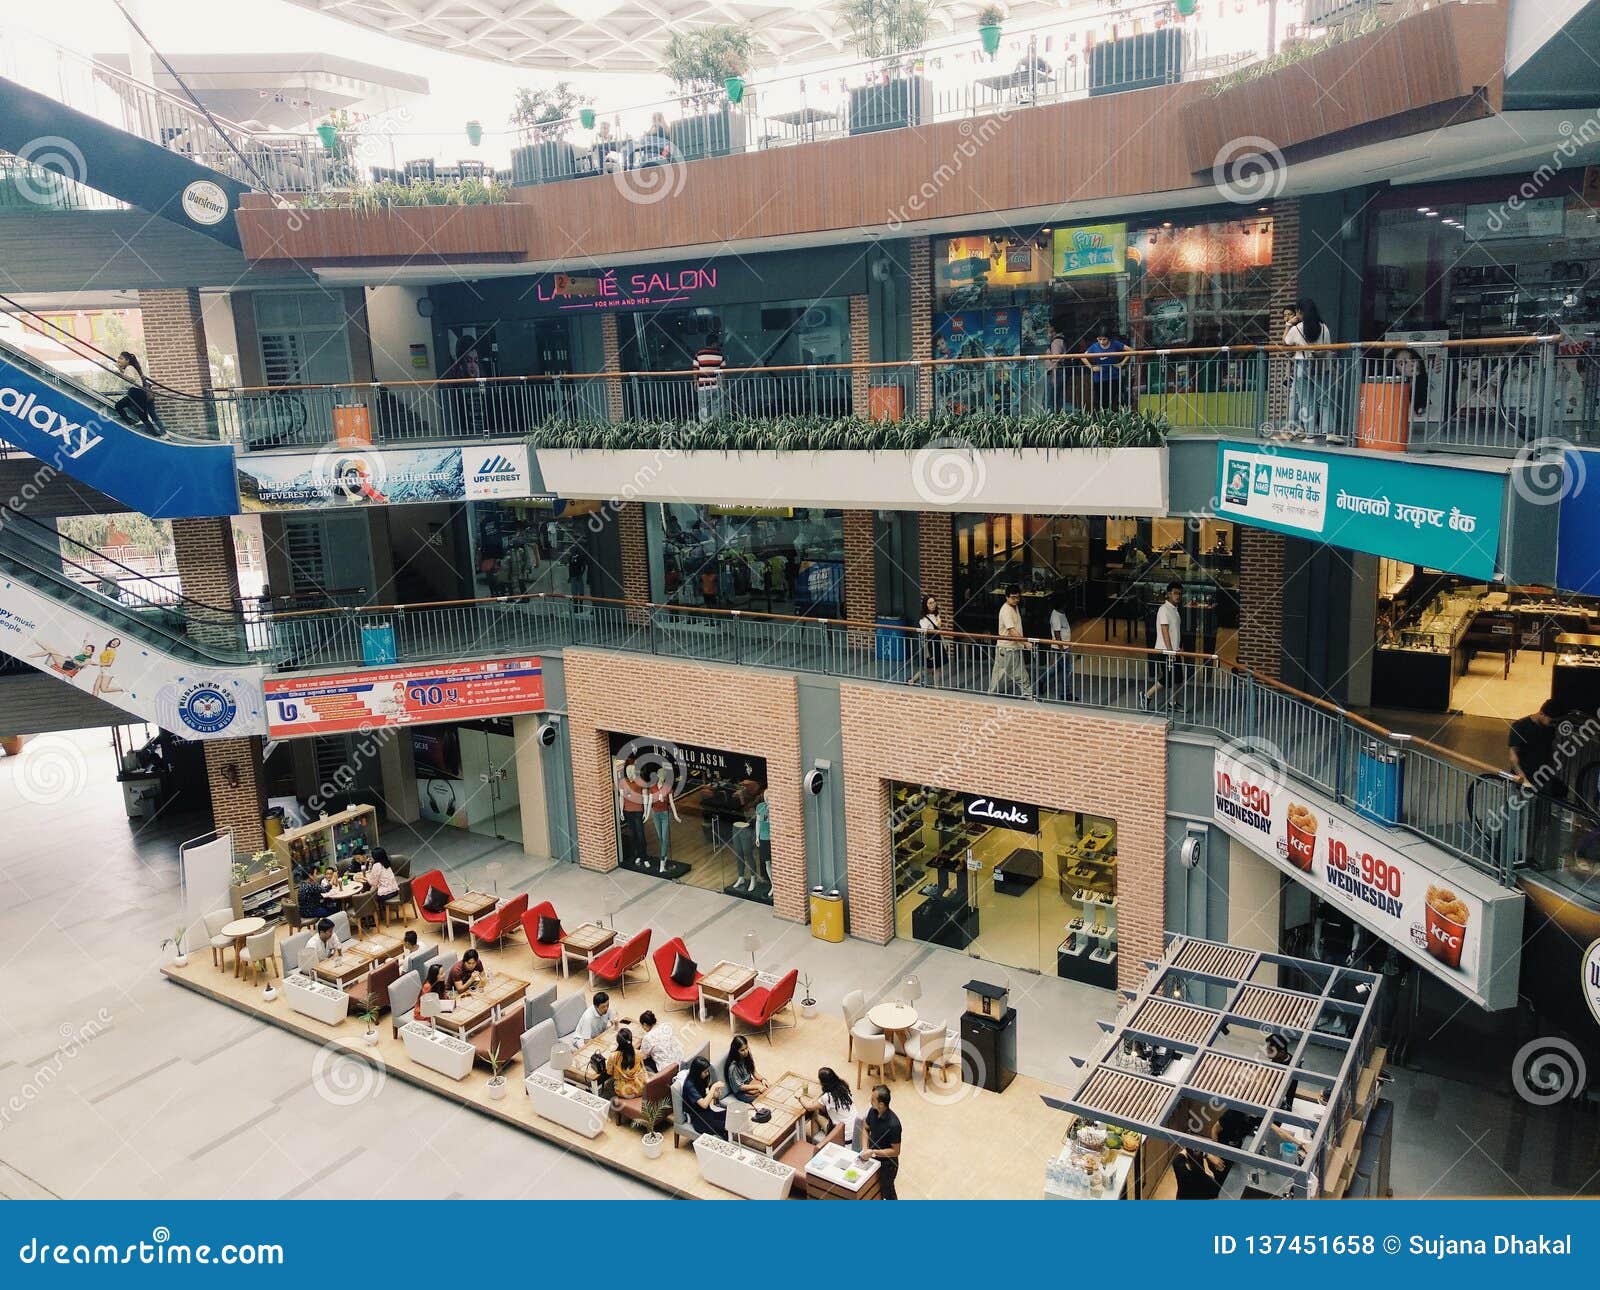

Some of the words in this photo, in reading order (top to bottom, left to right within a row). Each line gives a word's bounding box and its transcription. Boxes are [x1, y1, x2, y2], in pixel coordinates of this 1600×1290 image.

[631, 268, 718, 294] SALON
[473, 473, 521, 483] UPEVEREST
[1275, 466, 1294, 480] NMB
[1296, 469, 1321, 484] BANK
[259, 489, 333, 501] UPEVEREST.COM
[1336, 488, 1391, 518] नेपालको
[1448, 506, 1477, 533] बैंक
[13, 615, 36, 630] music
[180, 682, 205, 707] RUSLAN
[207, 682, 221, 690] FM
[653, 744, 669, 758] U.S.
[673, 747, 696, 763] POLO
[700, 752, 728, 769] ASSN.
[1216, 770, 1231, 799] 10
[1241, 780, 1270, 817] 990
[967, 798, 1029, 825] Clarks
[1216, 795, 1272, 835] WEDNESDAY
[1290, 835, 1312, 855] KFC
[1328, 837, 1347, 871] 10
[1347, 863, 1360, 878] FOR
[1361, 853, 1401, 898] 990
[1326, 865, 1404, 920] WEDNESDAY
[1430, 922, 1460, 950] KFC
